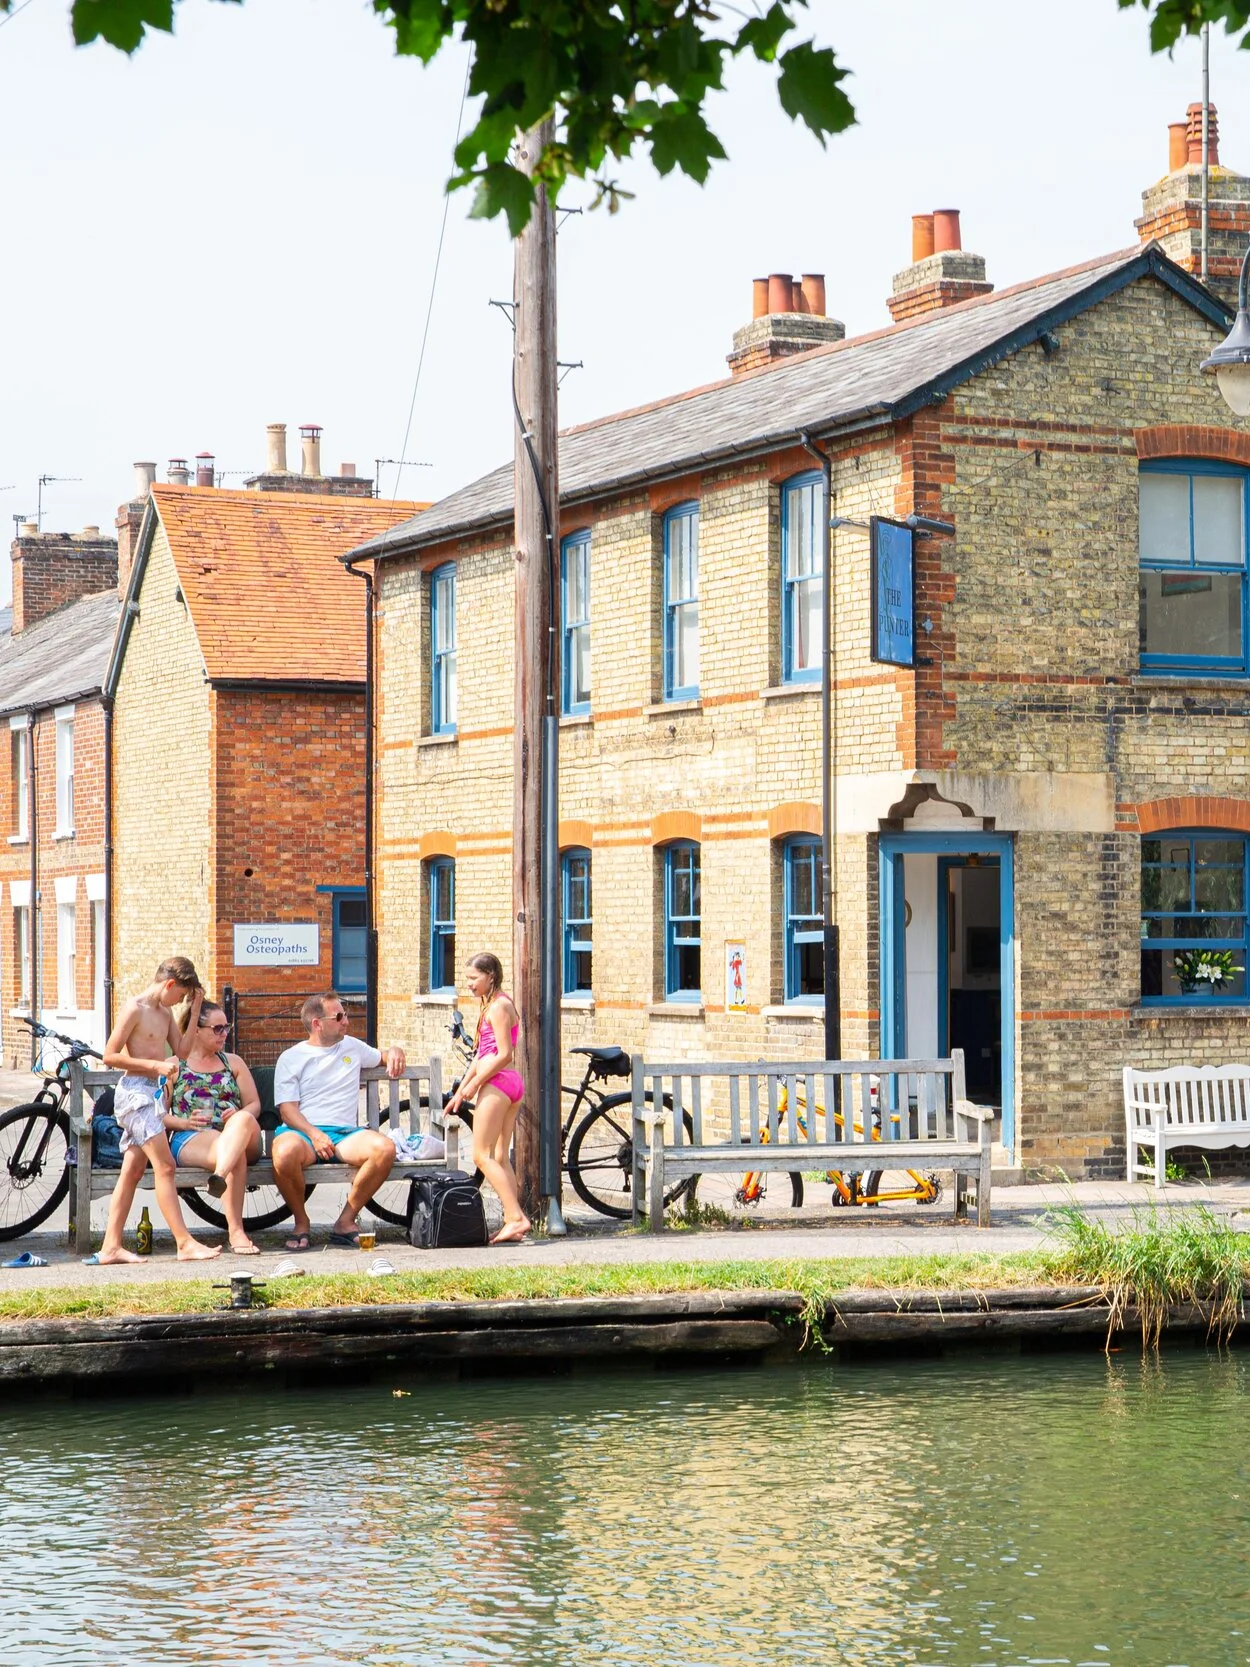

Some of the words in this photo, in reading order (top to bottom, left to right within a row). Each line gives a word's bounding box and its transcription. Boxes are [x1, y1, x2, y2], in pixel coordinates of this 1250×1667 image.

[886, 587, 902, 607] THE
[879, 614, 910, 637] PUNTER
[250, 935, 283, 946] Osney
[246, 944, 308, 955] Osteopaths
